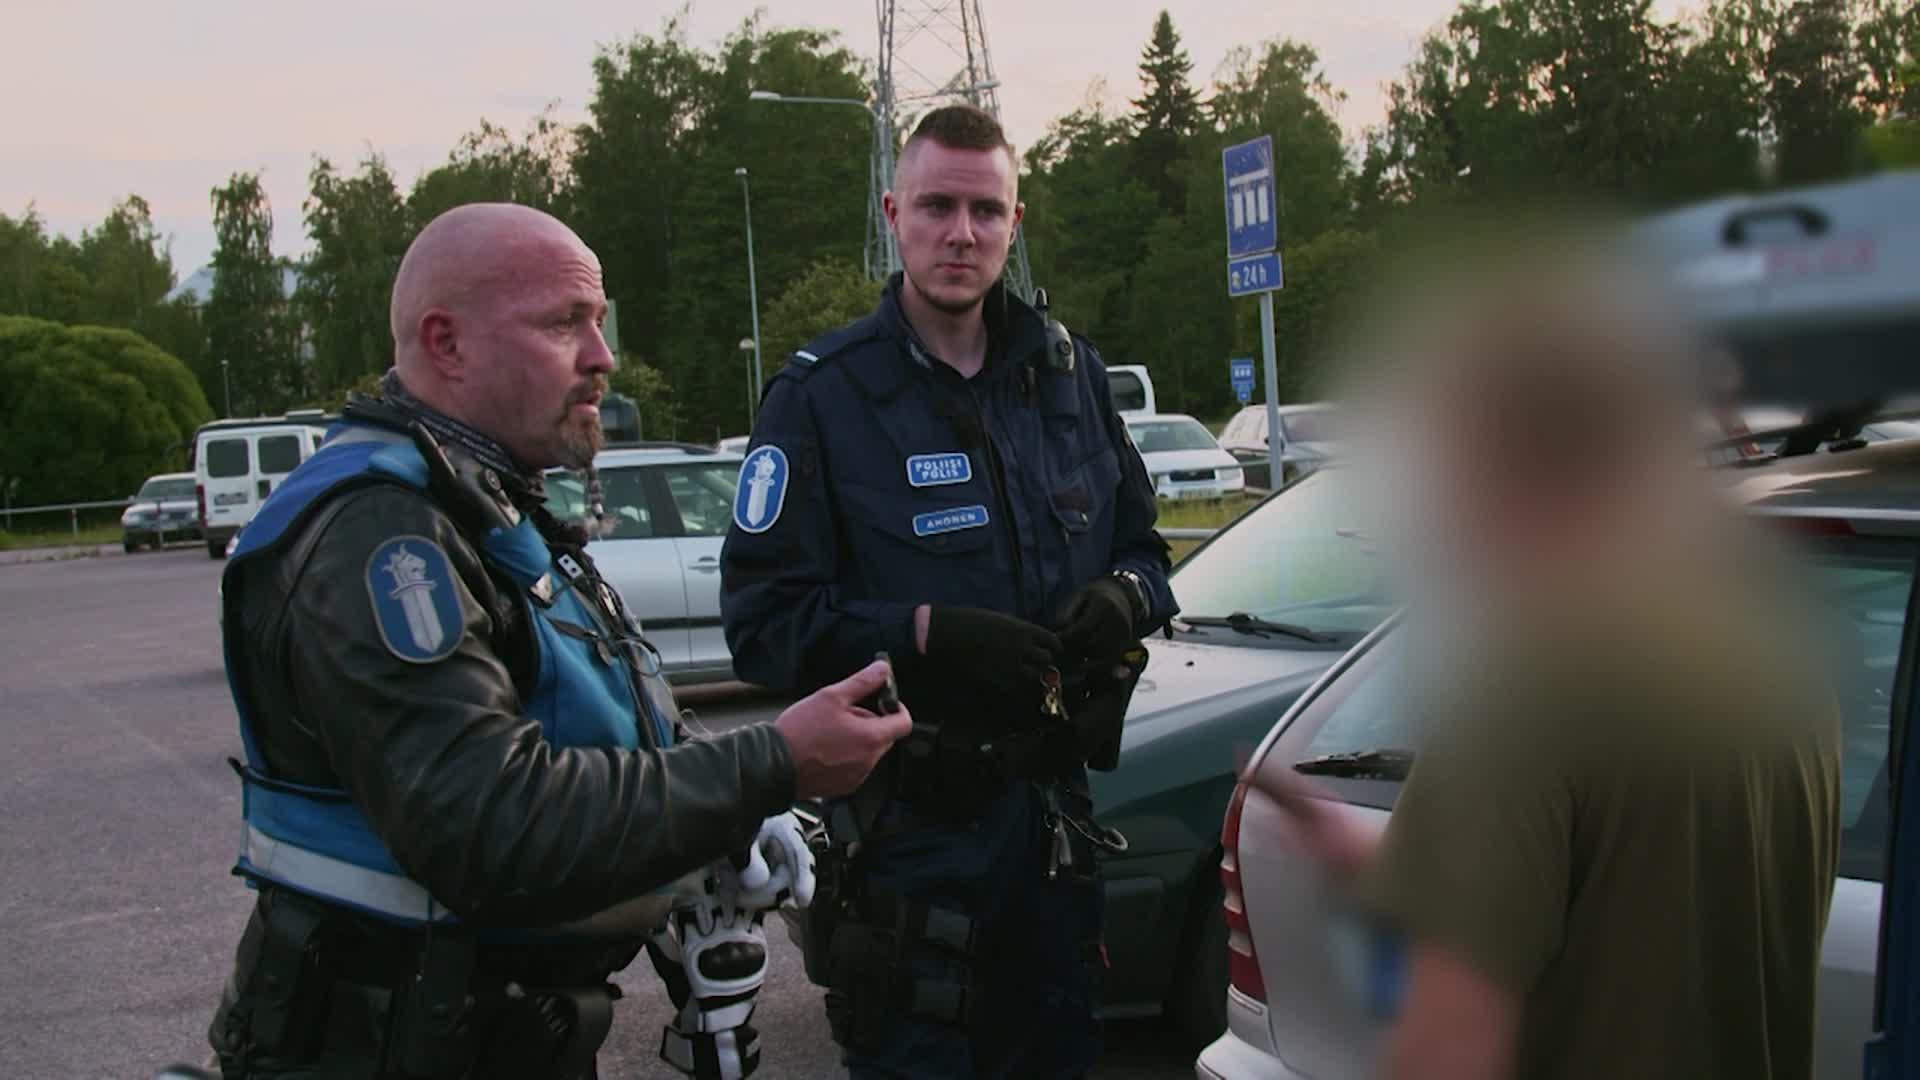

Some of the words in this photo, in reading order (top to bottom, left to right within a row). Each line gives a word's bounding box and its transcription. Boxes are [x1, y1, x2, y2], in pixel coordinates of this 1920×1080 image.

[1243, 264, 1257, 287] 24
[915, 459, 962, 472] POLIISI
[922, 469, 959, 480] POLIS
[927, 512, 976, 529] AHONEN
